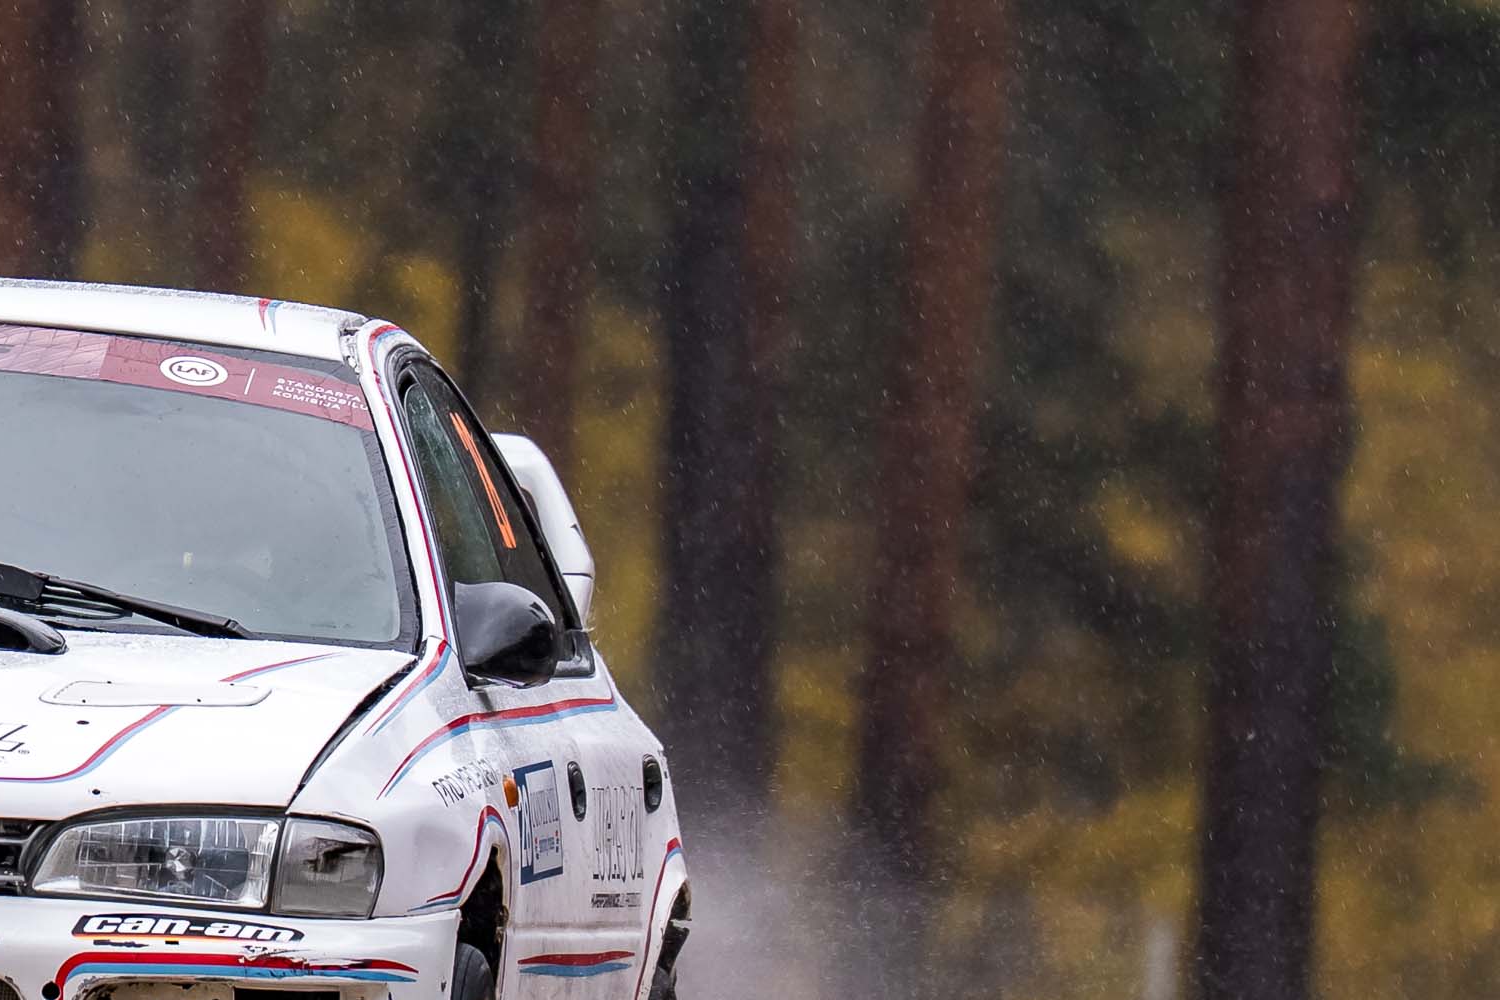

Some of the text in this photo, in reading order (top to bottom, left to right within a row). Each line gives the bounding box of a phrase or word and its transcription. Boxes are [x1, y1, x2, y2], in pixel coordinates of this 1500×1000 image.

[176, 365, 212, 377] LAF
[272, 390, 341, 411] KOMISIJA
[83, 916, 296, 942] can-am
